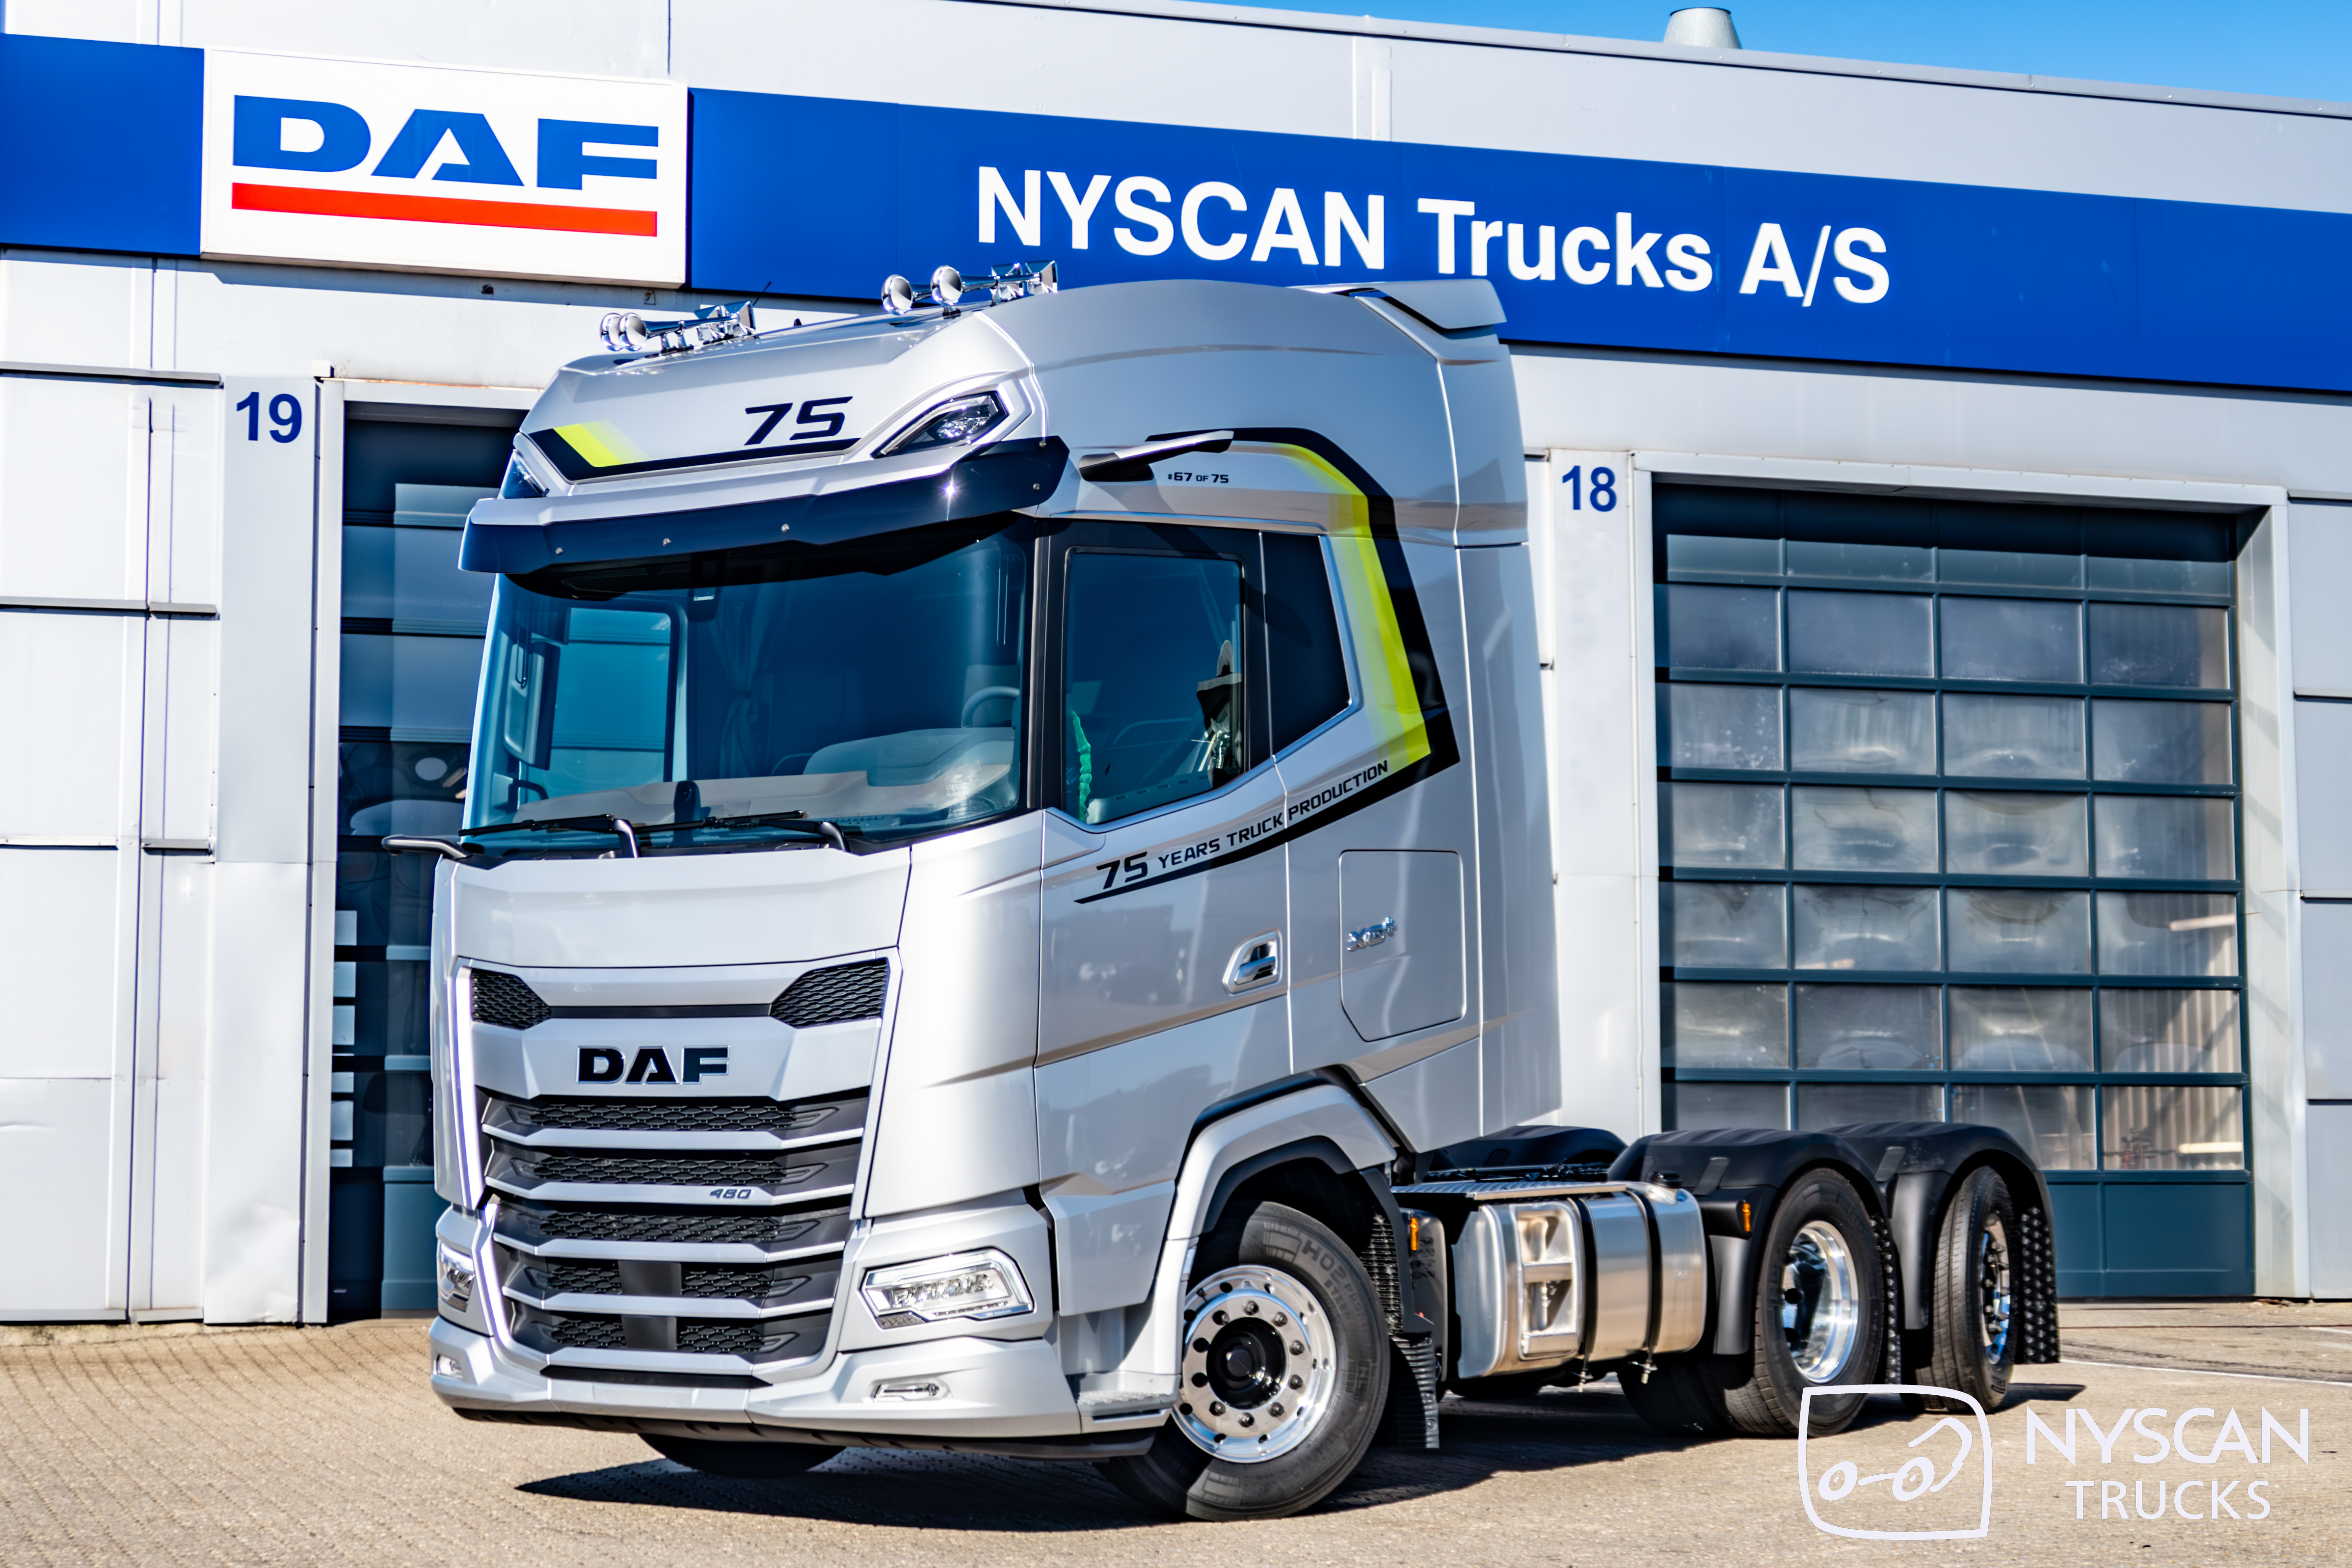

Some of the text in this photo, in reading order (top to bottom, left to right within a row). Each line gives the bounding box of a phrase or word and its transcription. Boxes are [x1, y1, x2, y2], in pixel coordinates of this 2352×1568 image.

[233, 95, 659, 190] DAF
[979, 166, 1889, 307] NYSCAN Trucks A/S
[236, 391, 302, 444] 19
[744, 396, 853, 446] 75
[1168, 472, 1193, 481] #67
[1211, 474, 1229, 483] 75
[1562, 465, 1617, 512] 18
[1096, 760, 1389, 890] 75 YEARS TRUCK PRODUCTION
[576, 1045, 730, 1085] DAF
[709, 1188, 751, 1199] 480
